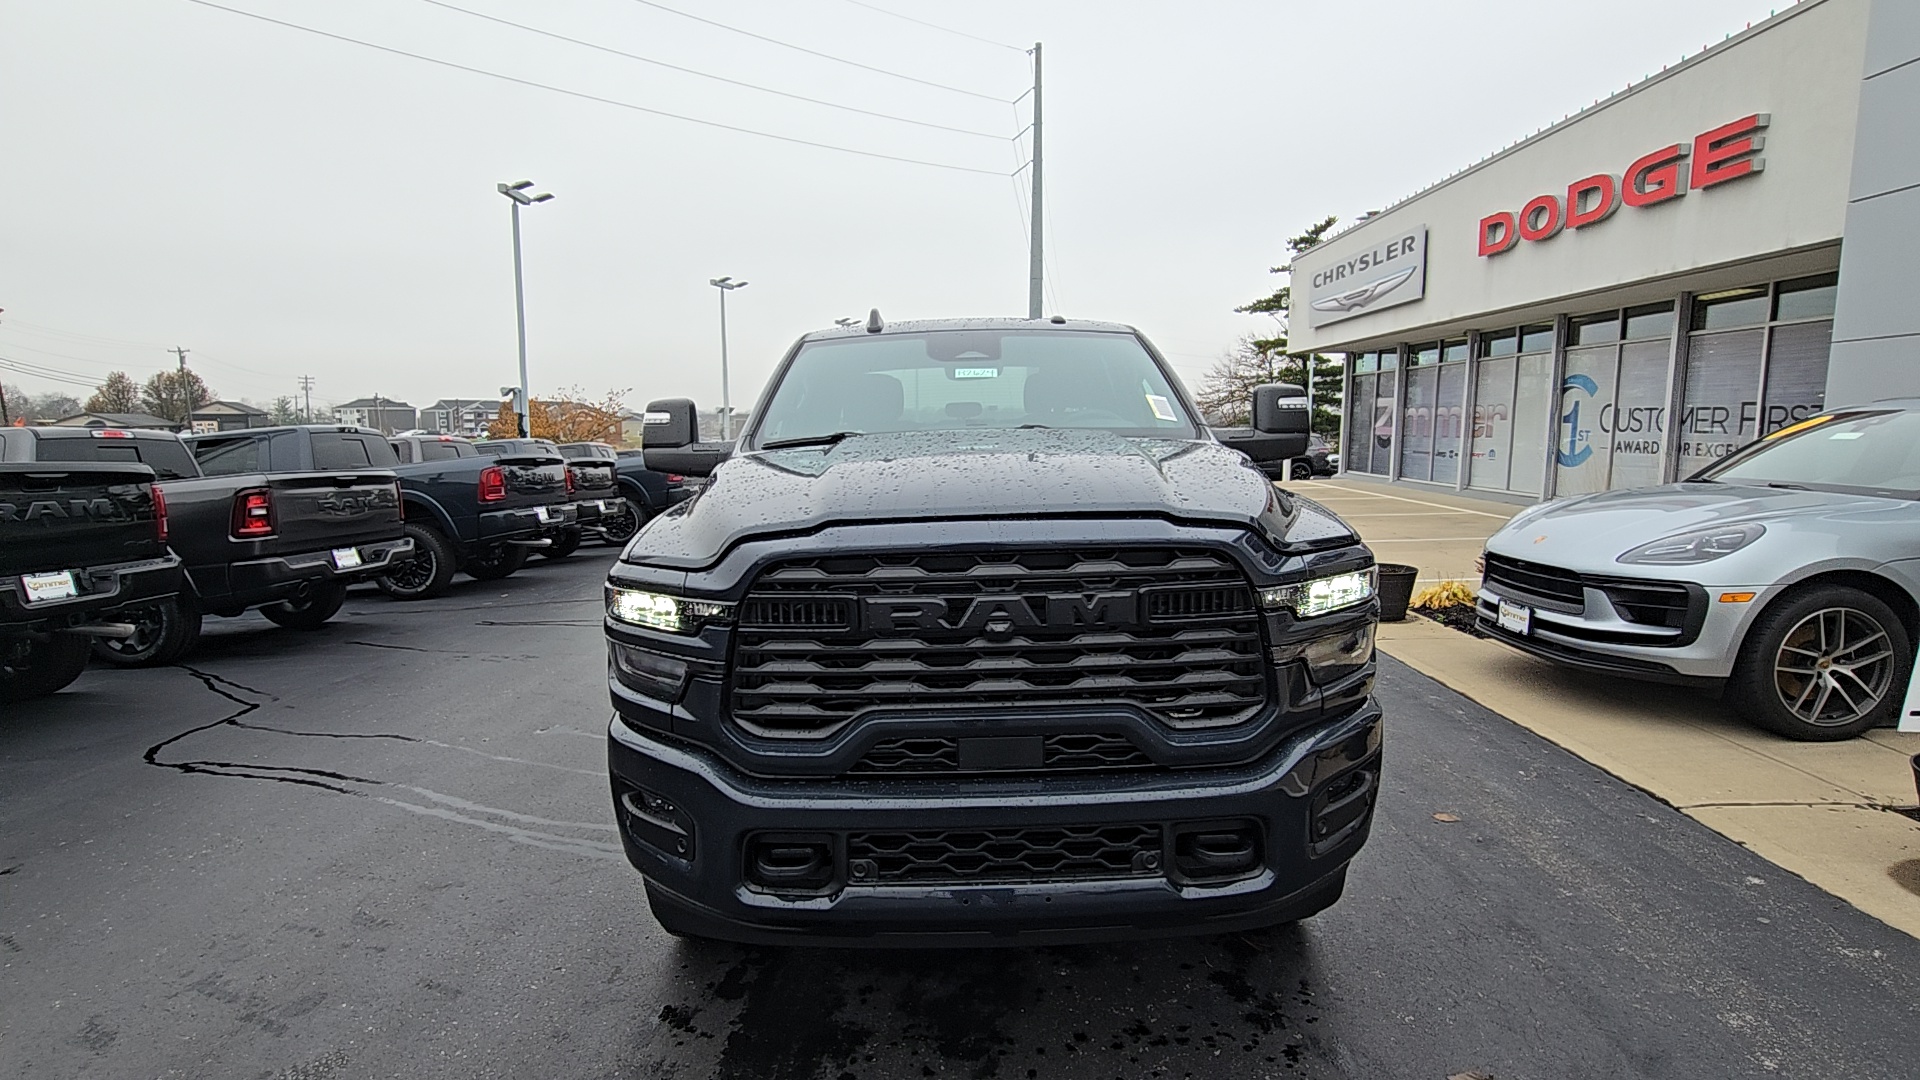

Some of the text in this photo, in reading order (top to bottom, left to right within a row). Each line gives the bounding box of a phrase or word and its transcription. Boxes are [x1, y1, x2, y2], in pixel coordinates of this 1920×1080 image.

[1478, 113, 1770, 257] DODGE
[1312, 235, 1416, 289] CHRYSLER
[1374, 397, 1508, 439] Zmmer
[1737, 402, 1825, 435] FRS
[1614, 441, 1660, 455] AWARD
[1695, 443, 1740, 458] EXCE
[864, 593, 1138, 631] RAM
